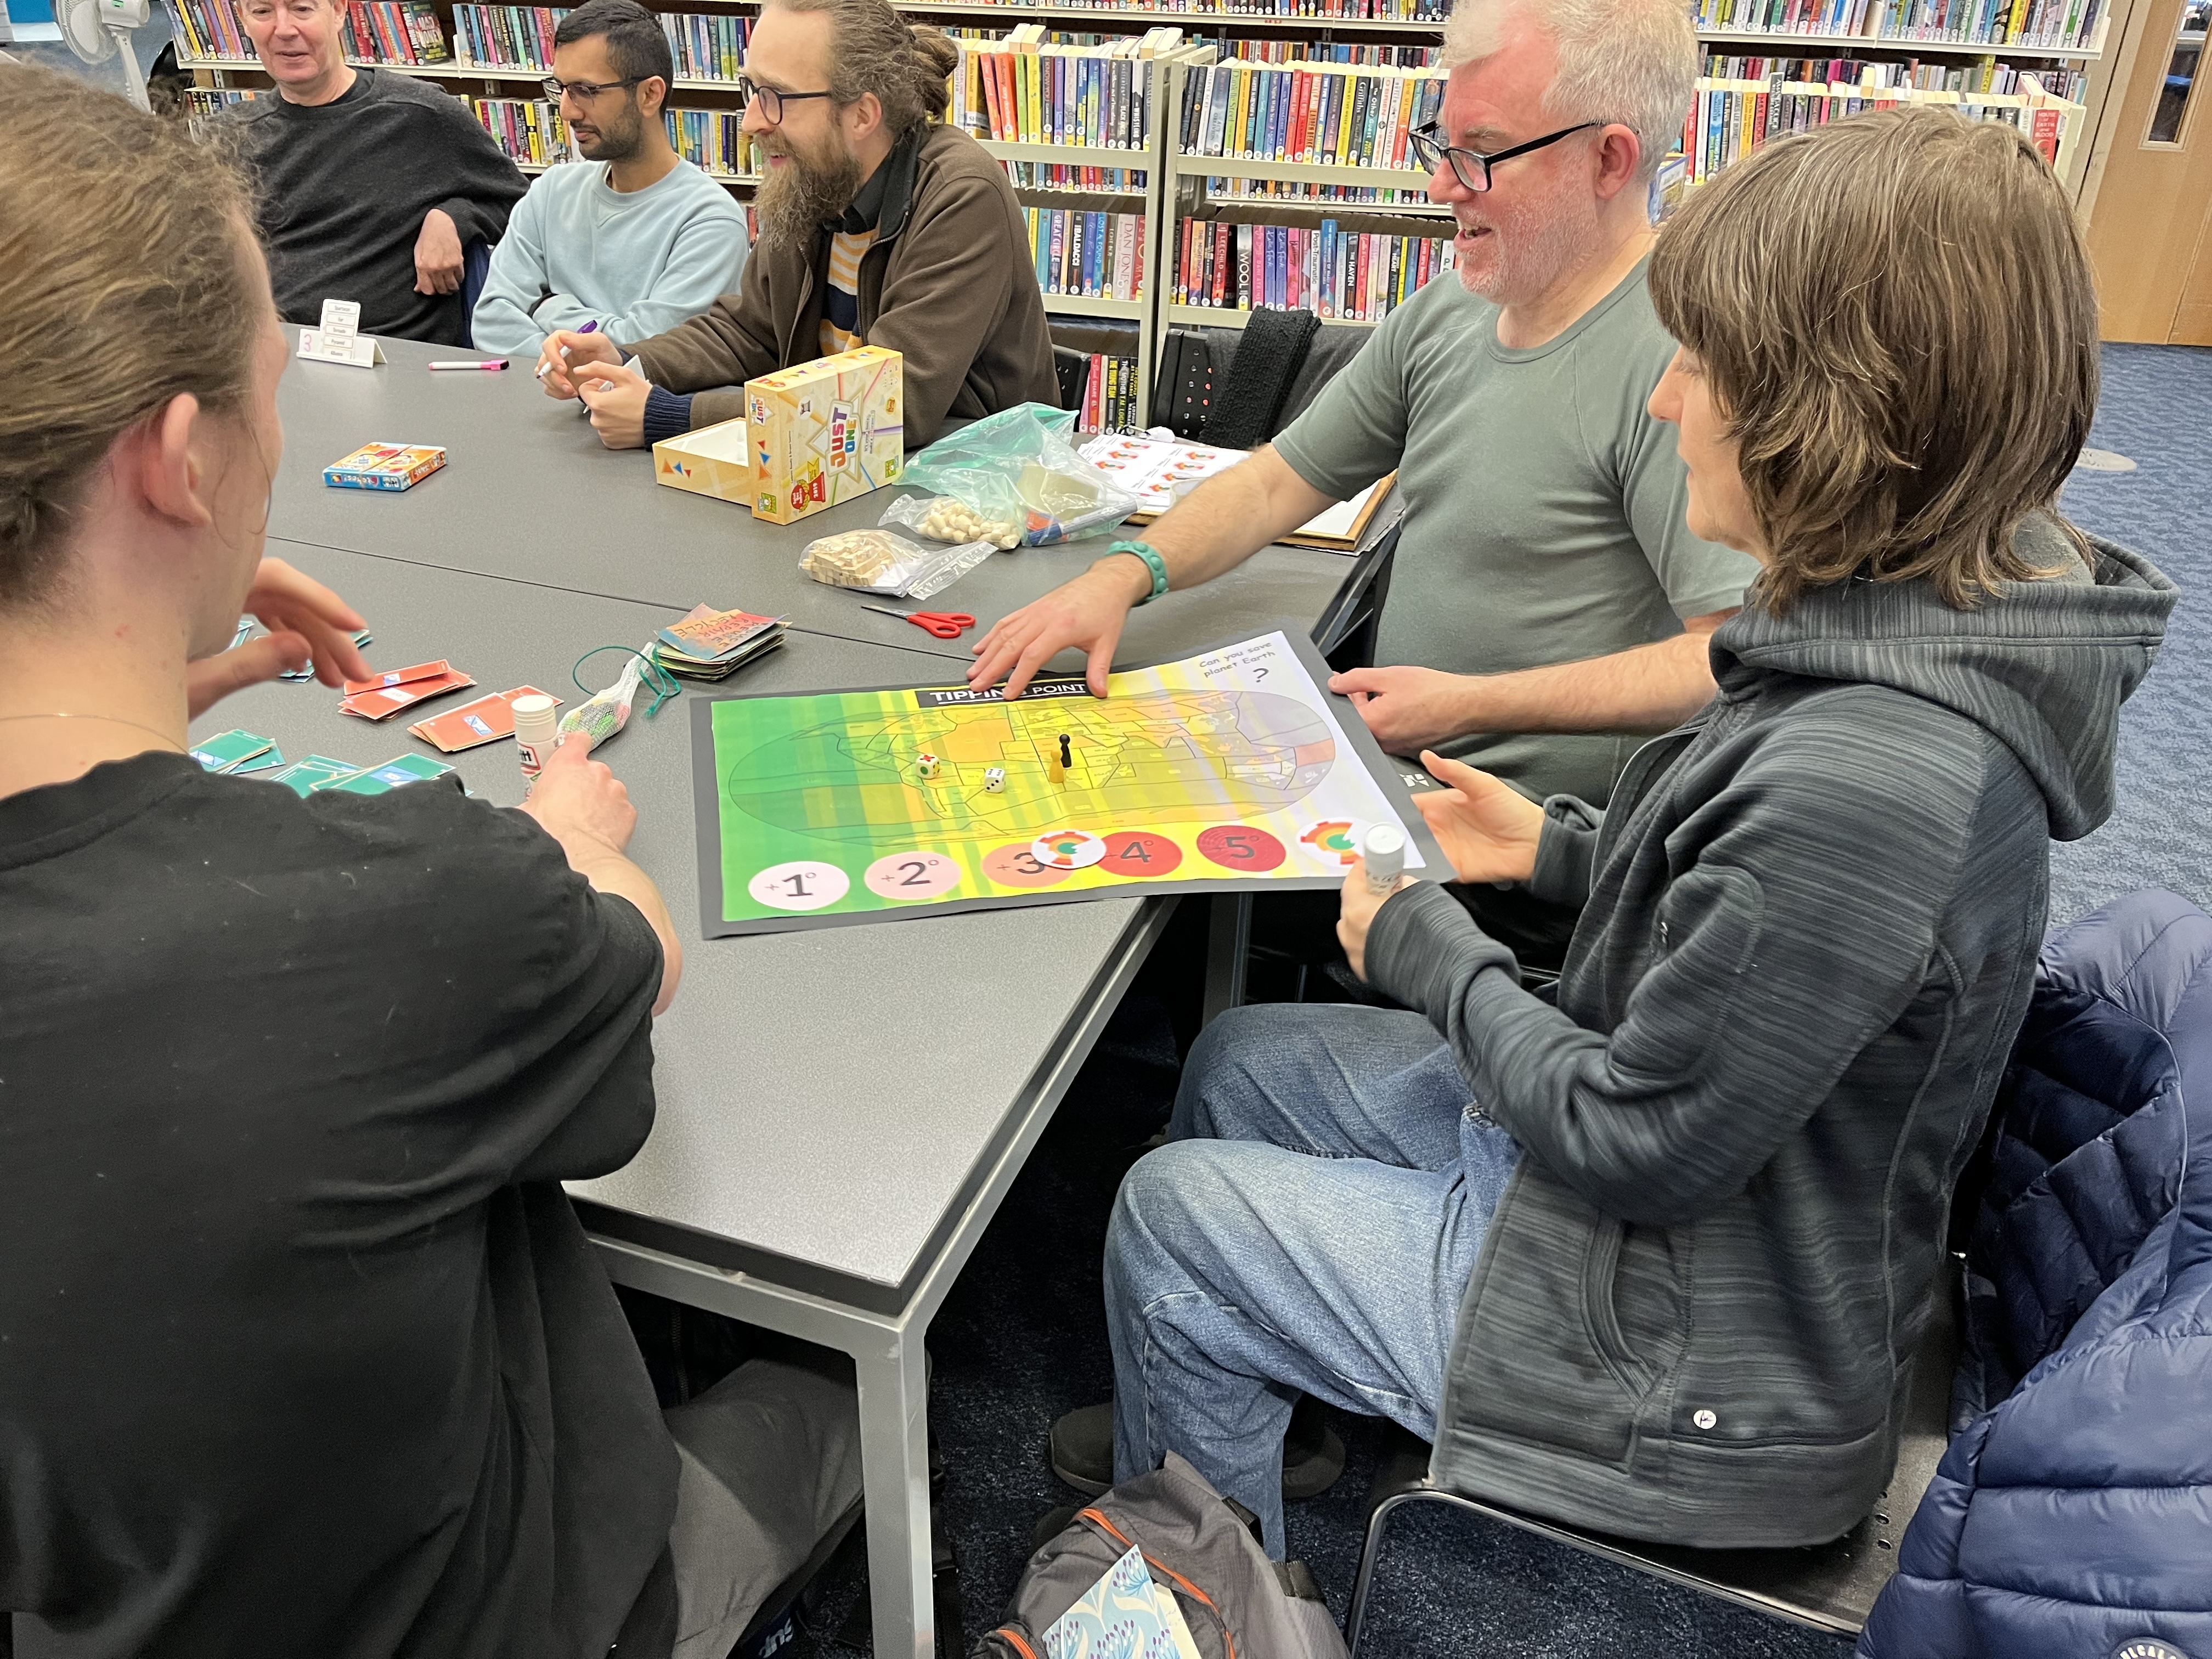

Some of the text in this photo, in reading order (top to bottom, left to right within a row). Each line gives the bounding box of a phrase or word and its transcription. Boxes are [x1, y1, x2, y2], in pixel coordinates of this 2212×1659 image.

[1228, 71, 1239, 121] Danielle Steel
[1310, 77, 1322, 109] MOXYLAND
[1357, 82, 1366, 113] Griffiths
[1308, 110, 1316, 130] LAUREN
[1369, 97, 1378, 117] Other
[1306, 132, 1314, 148] BEUKE
[1385, 121, 1395, 154] KINDRED
[1052, 215, 1062, 262] GREAT CIRCLE
[1120, 223, 1133, 285] DAN JONES
[1239, 252, 1249, 289] WOOL
[304, 334, 312, 352] 3
[1108, 360, 1118, 398] THE YOUNG TEAM
[756, 399, 764, 424] JUST
[830, 407, 848, 468] JUST
[845, 419, 857, 453] ONE
[674, 614, 736, 637] RECYCLE
[698, 618, 749, 637] REPAIR
[1199, 642, 1272, 668] Can you save
[1204, 651, 1276, 678] planet Earth
[1252, 668, 1269, 683] ?
[929, 684, 1086, 702] TIPPIN POINT
